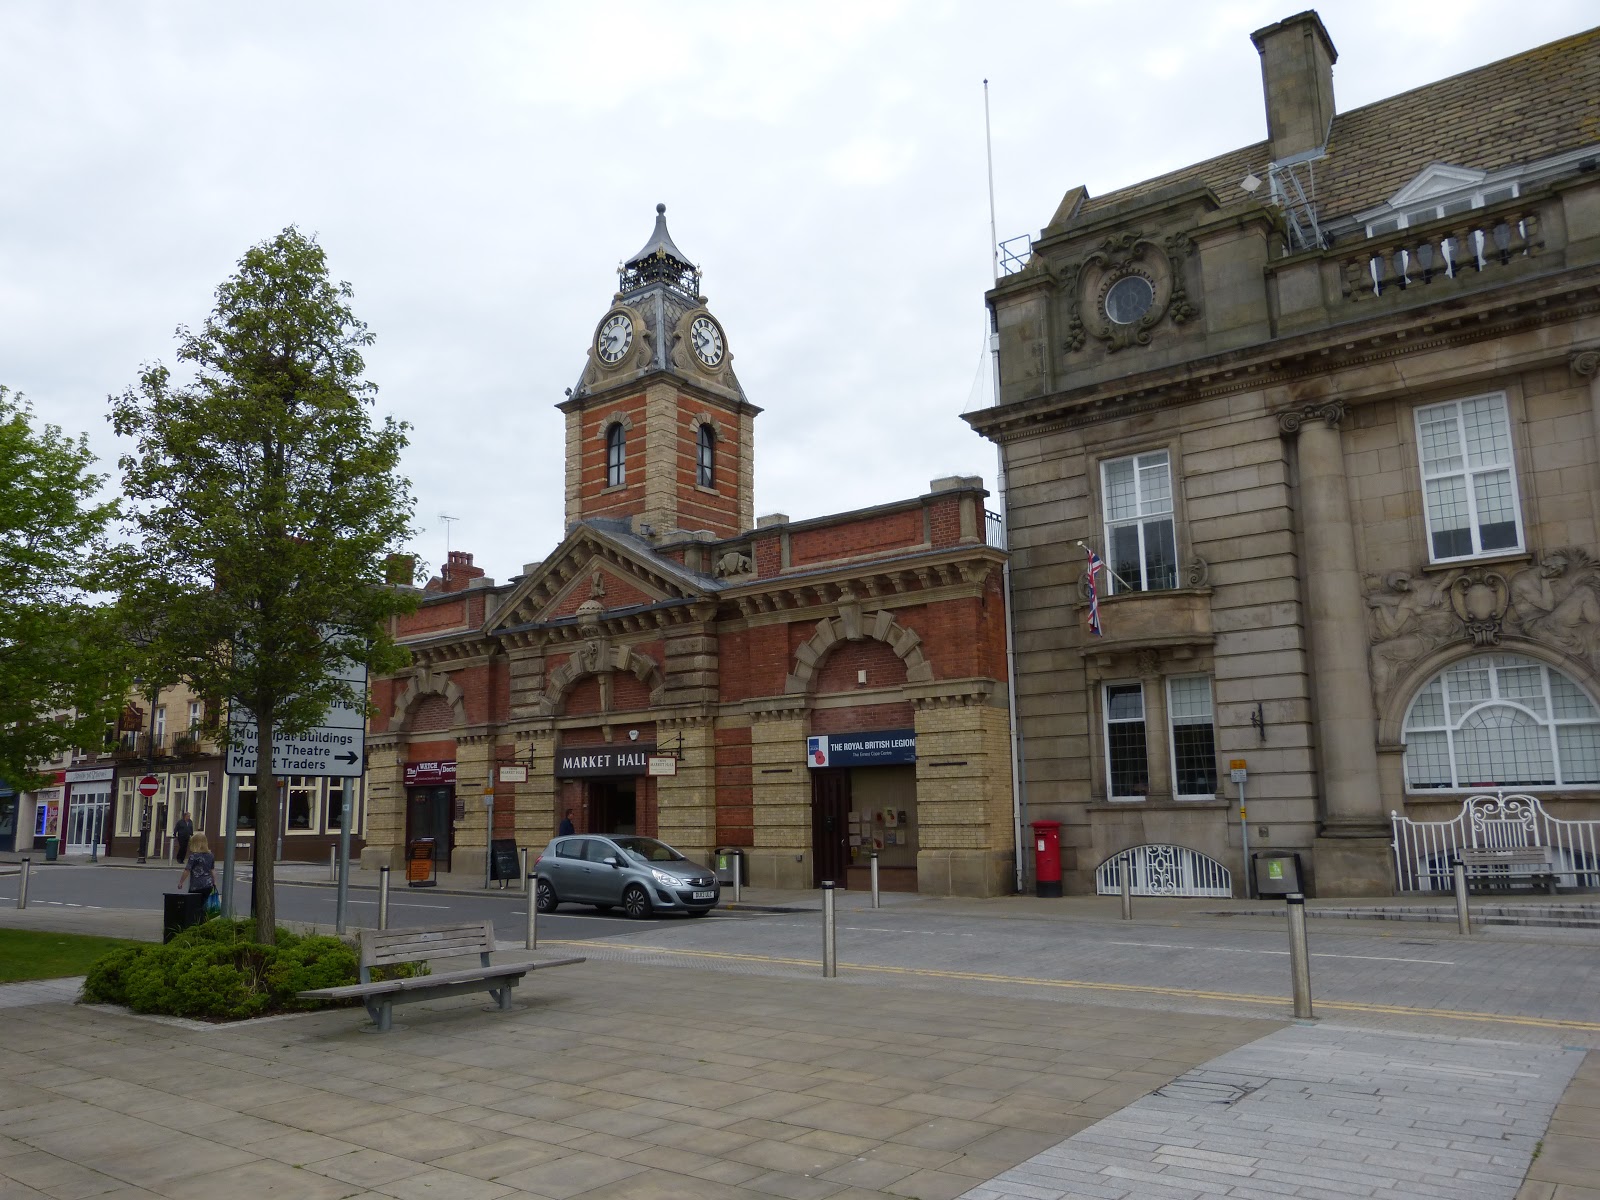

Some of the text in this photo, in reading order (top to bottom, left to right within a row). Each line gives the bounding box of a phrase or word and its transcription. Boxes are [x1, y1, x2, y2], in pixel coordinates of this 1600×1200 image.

[234, 729, 353, 745] Munipal Buildings
[233, 743, 331, 756] Lycem Theatre
[831, 739, 915, 751] THE ROYAL BRITISH LEGION
[232, 756, 326, 770] Mart Traders
[563, 753, 646, 769] MARKET HALL
